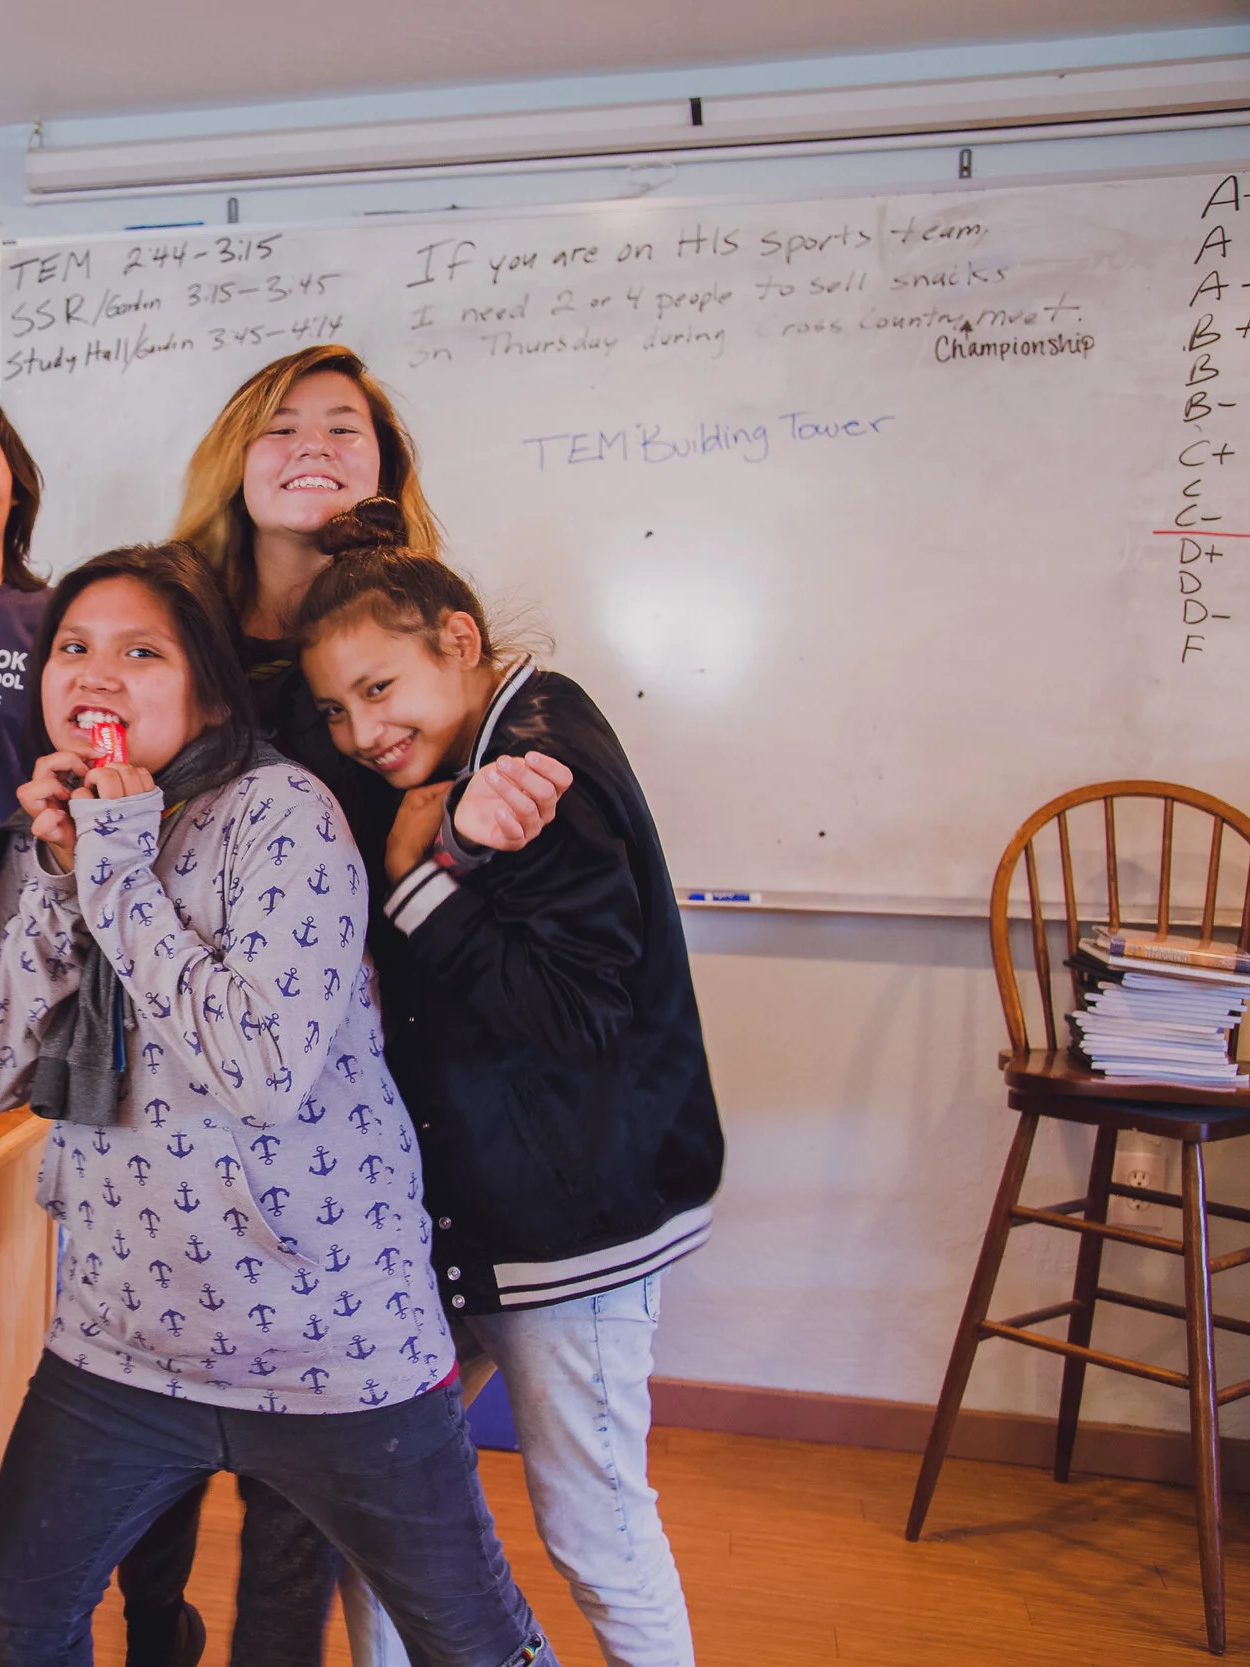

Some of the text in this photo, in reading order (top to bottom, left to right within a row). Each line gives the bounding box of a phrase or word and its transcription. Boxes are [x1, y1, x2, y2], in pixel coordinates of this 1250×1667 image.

[1201, 175, 1250, 219] A
[1194, 225, 1232, 264] A
[9, 249, 91, 290] TEM
[406, 239, 476, 287] If
[489, 252, 538, 284] you
[552, 245, 598, 267] are
[617, 243, 653, 263] on
[410, 261, 1008, 331] I need 2 or 4 people to sell snacks
[480, 328, 618, 358] Thursday
[643, 325, 727, 360] during
[935, 334, 1095, 363] Championship
[3, 345, 77, 381] Study
[1186, 353, 1220, 387] B
[522, 431, 629, 471] TEM
[779, 411, 897, 441] Tower
[1179, 440, 1235, 466] C+
[1183, 479, 1202, 497] C
[1175, 504, 1222, 527] C-
[1180, 538, 1223, 564] D+
[1179, 571, 1202, 594] D
[1183, 599, 1231, 625] D-
[1182, 635, 1205, 664] F
